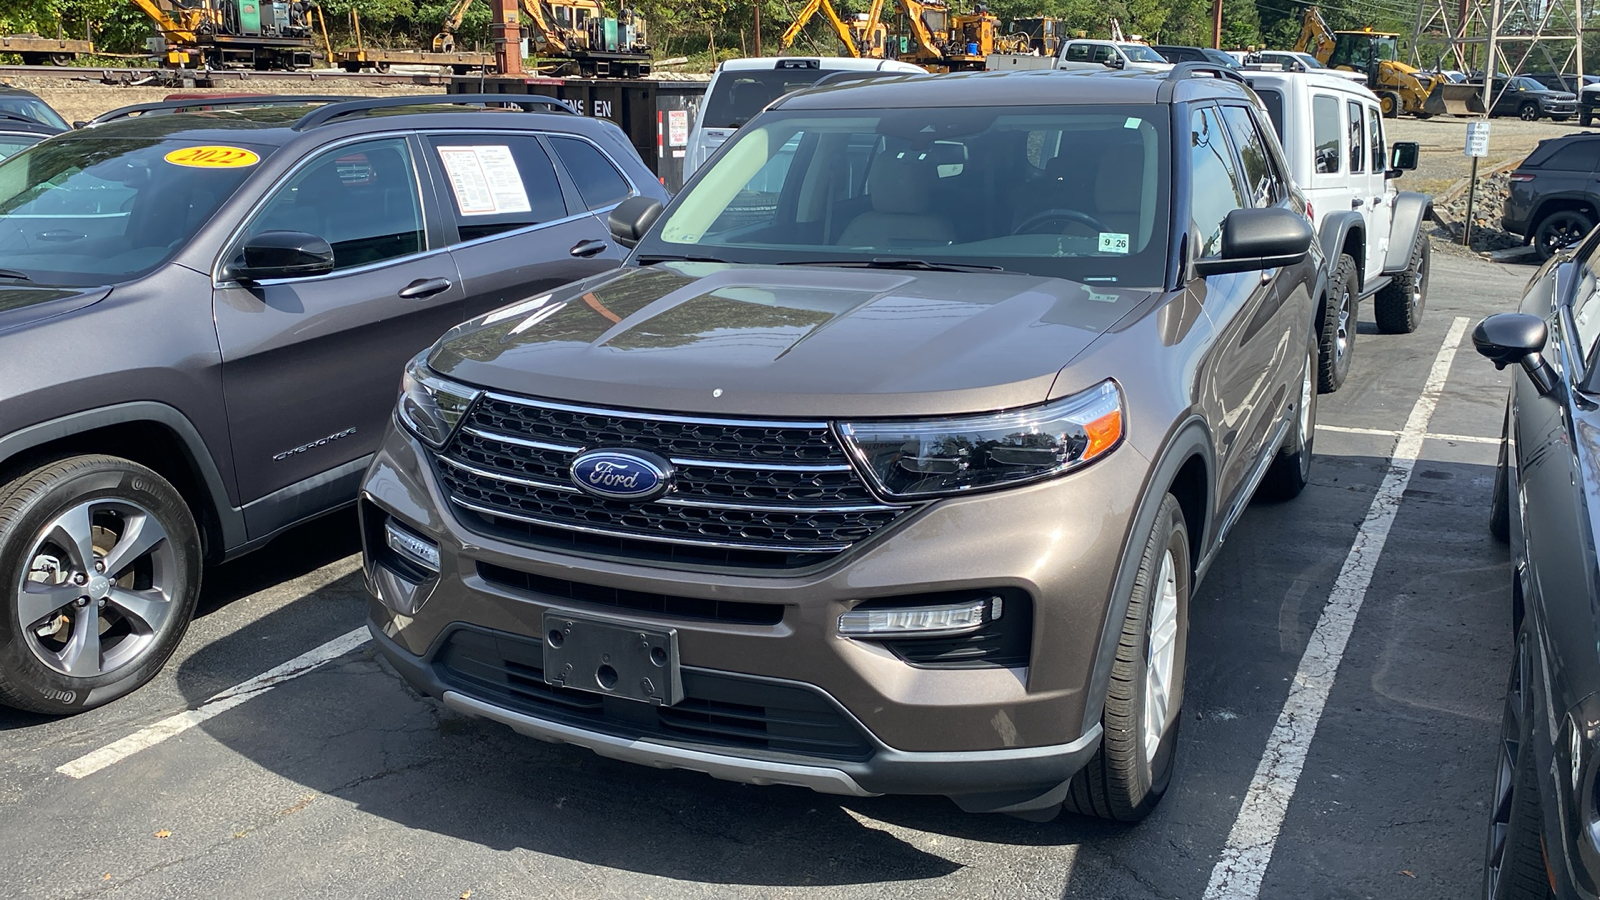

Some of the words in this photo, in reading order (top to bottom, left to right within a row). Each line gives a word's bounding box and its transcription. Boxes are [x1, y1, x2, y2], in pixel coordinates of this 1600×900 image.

[174, 149, 247, 164] 2022
[1104, 238, 1111, 246] 9
[1115, 239, 1126, 248] 26
[589, 461, 640, 488] Ford
